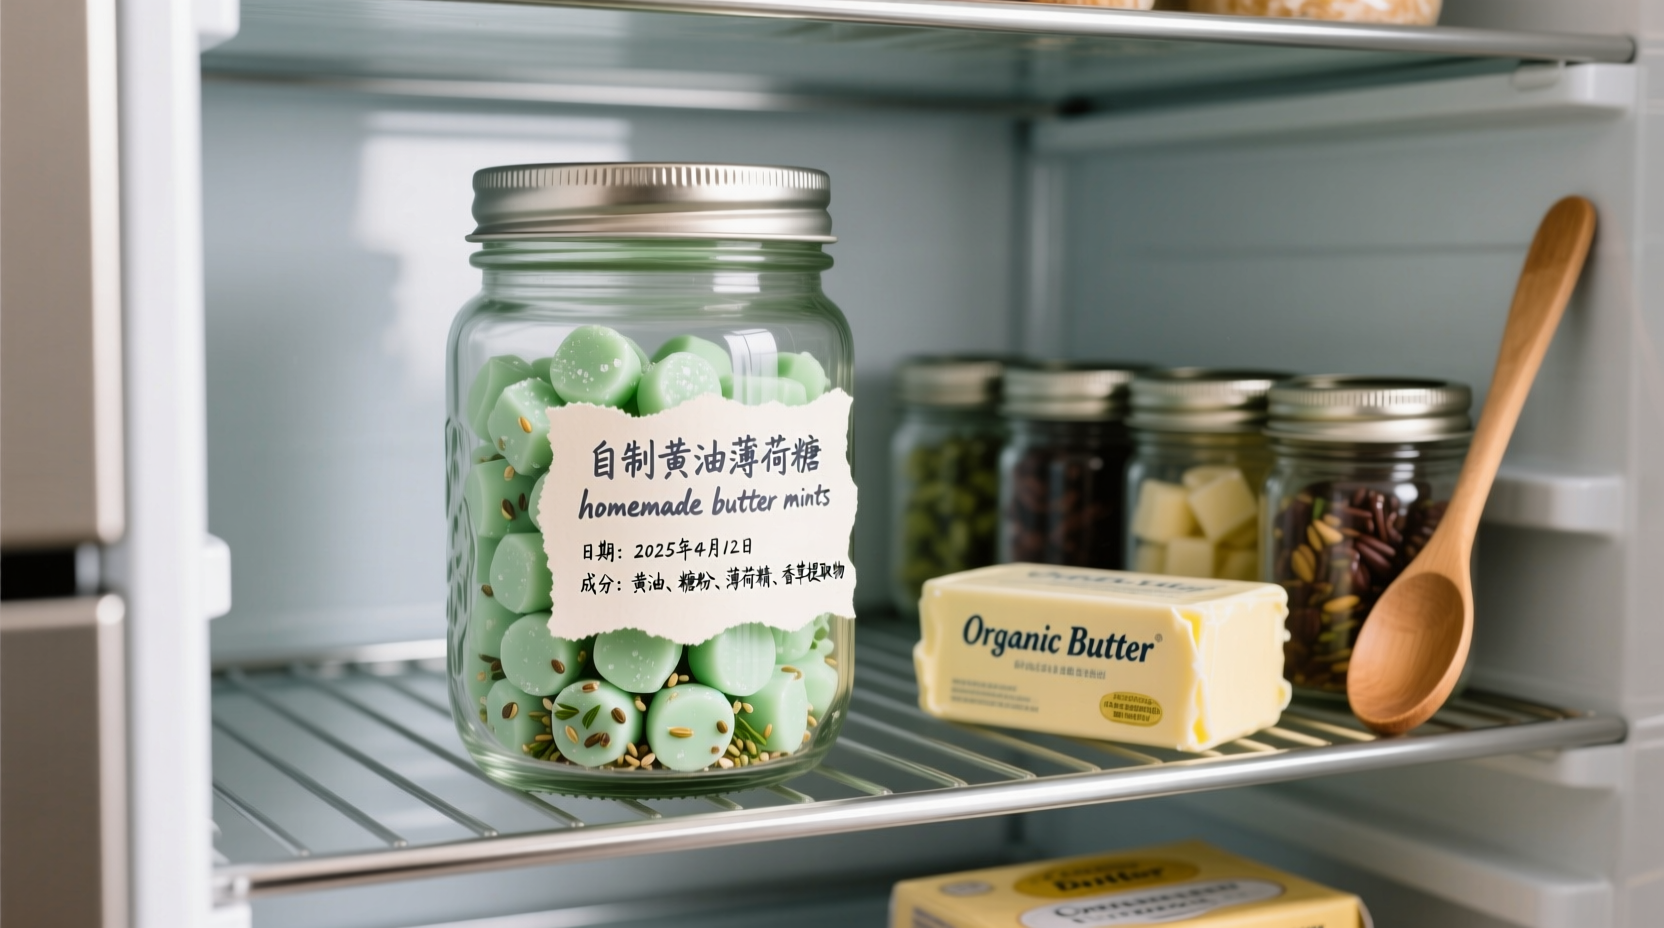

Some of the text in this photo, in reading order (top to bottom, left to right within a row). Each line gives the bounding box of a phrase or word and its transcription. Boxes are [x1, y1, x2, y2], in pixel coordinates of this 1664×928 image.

[592, 434, 822, 480] 自制黄油薄荷糖
[578, 483, 831, 520] homemade butter mints
[962, 614, 1155, 663] Organic Butter
